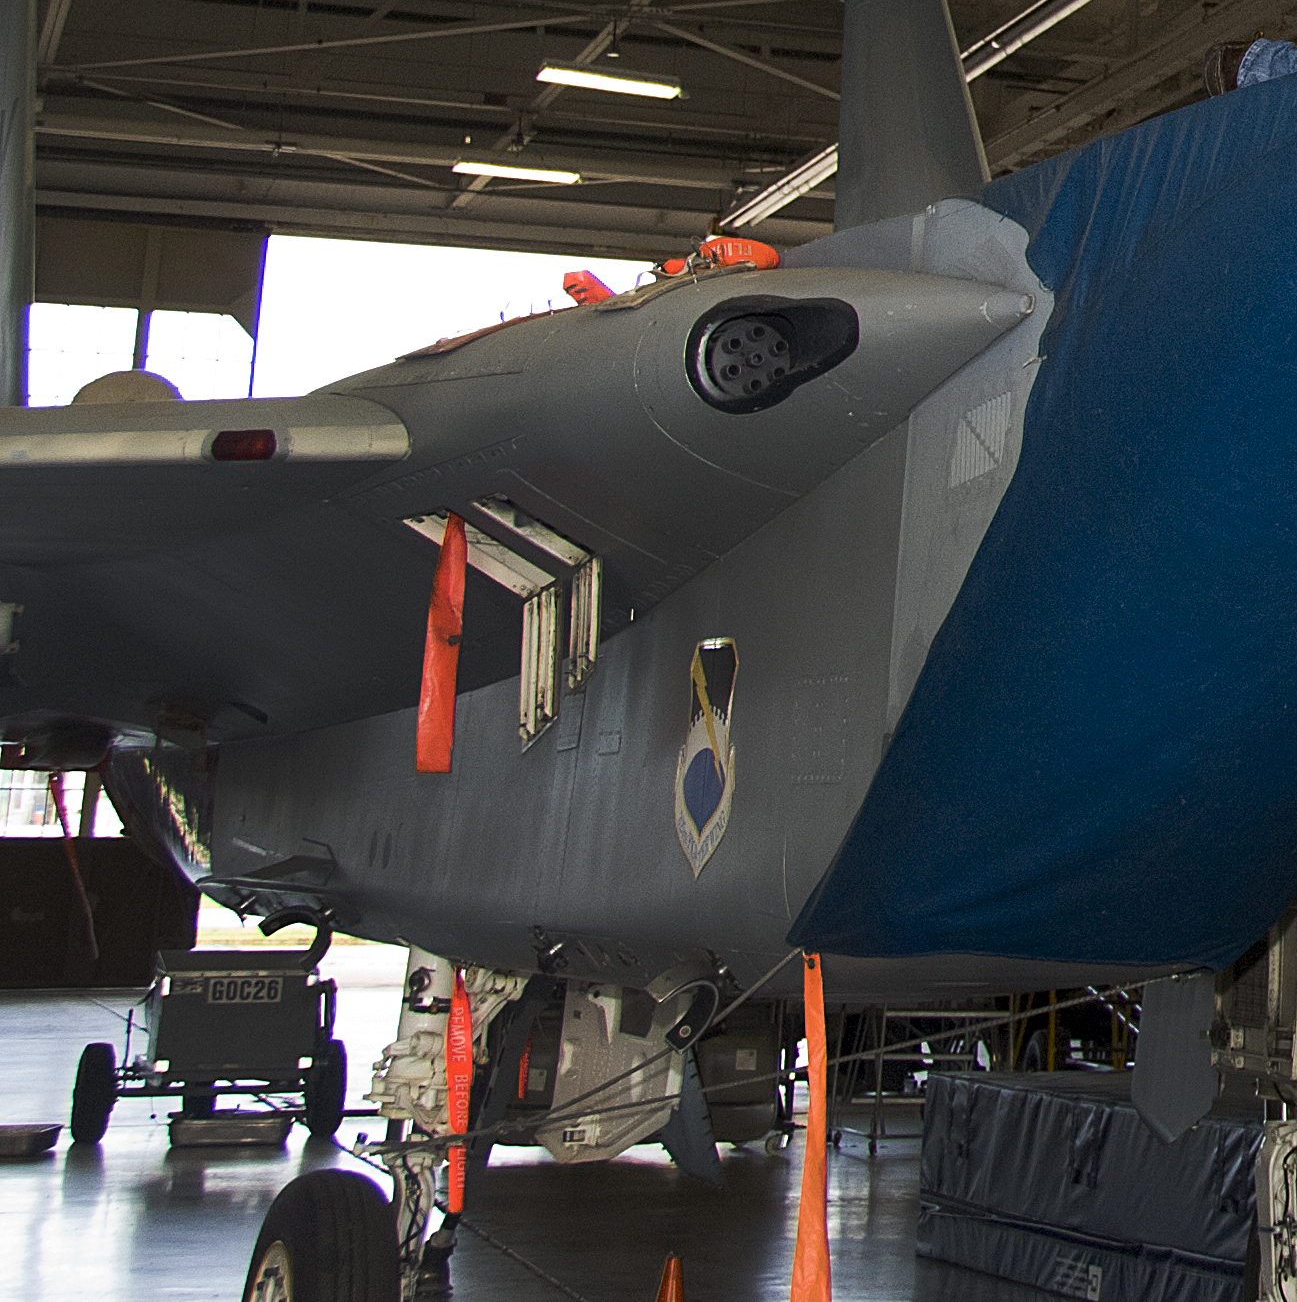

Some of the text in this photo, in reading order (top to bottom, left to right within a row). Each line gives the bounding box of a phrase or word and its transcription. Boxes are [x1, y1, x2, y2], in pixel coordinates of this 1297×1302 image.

[452, 1006, 469, 1190] REMOVE BEFORE LIGHT
